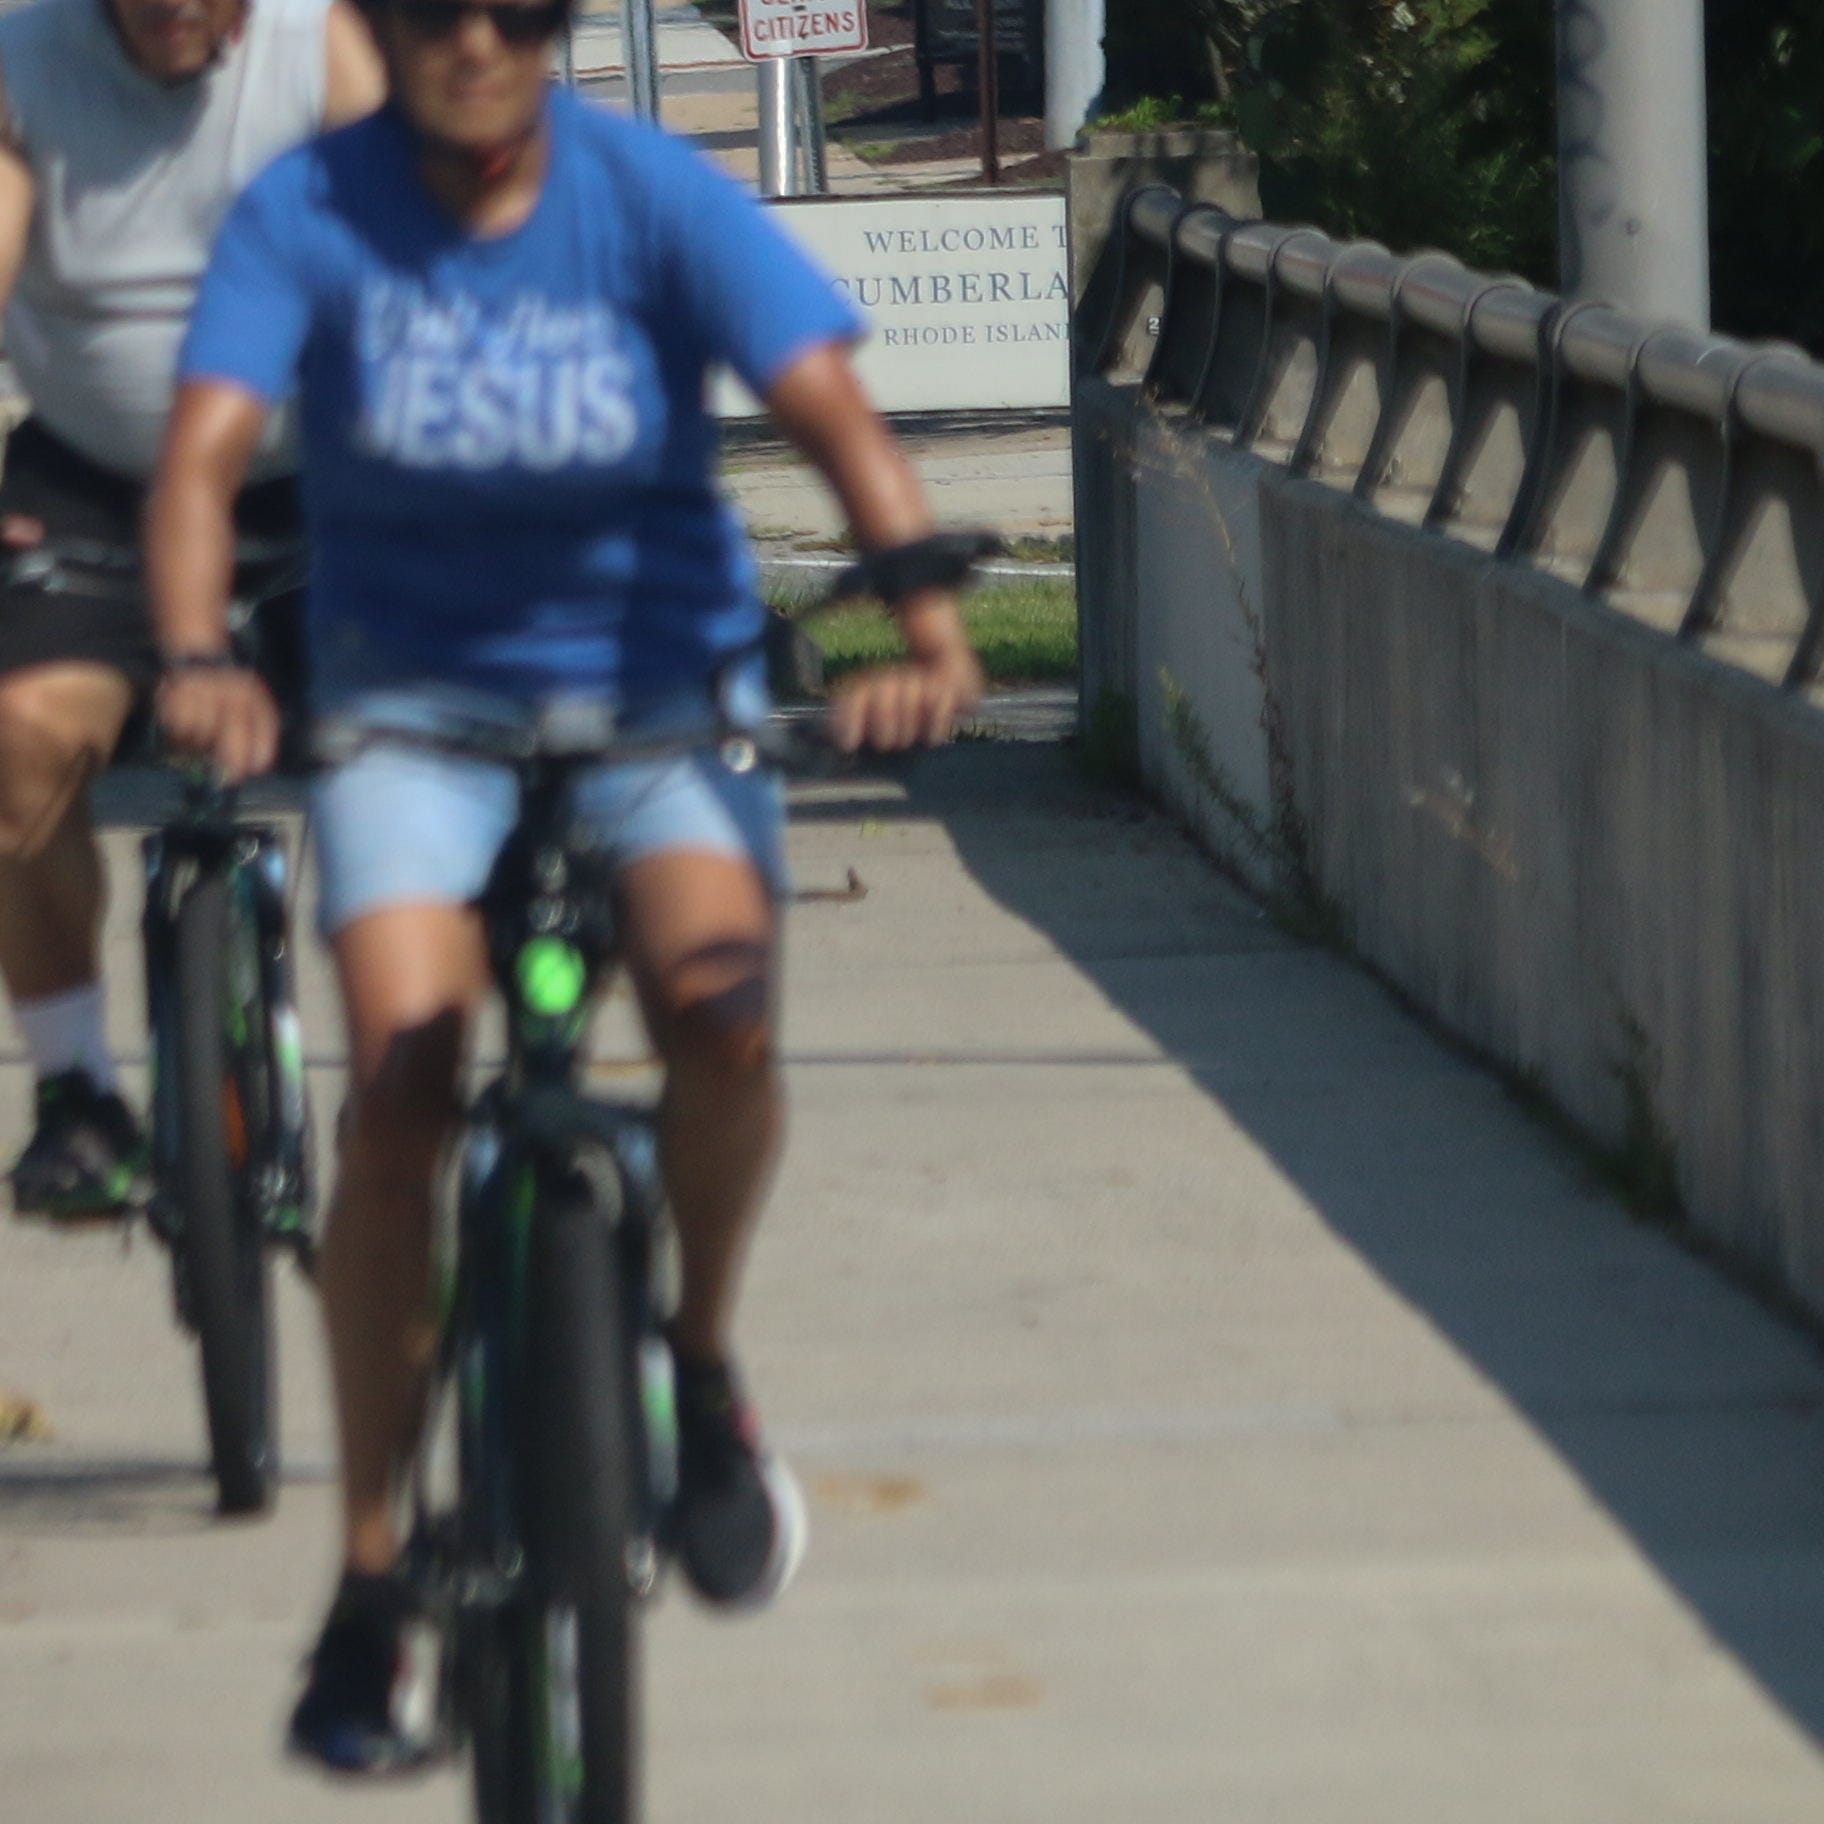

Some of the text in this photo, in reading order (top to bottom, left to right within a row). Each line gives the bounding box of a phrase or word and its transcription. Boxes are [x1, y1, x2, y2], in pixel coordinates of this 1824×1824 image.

[754, 11, 855, 42] CITIZENS
[863, 226, 1039, 254] WELCOME
[883, 326, 976, 347] RHODE
[370, 352, 638, 471] JESUS
